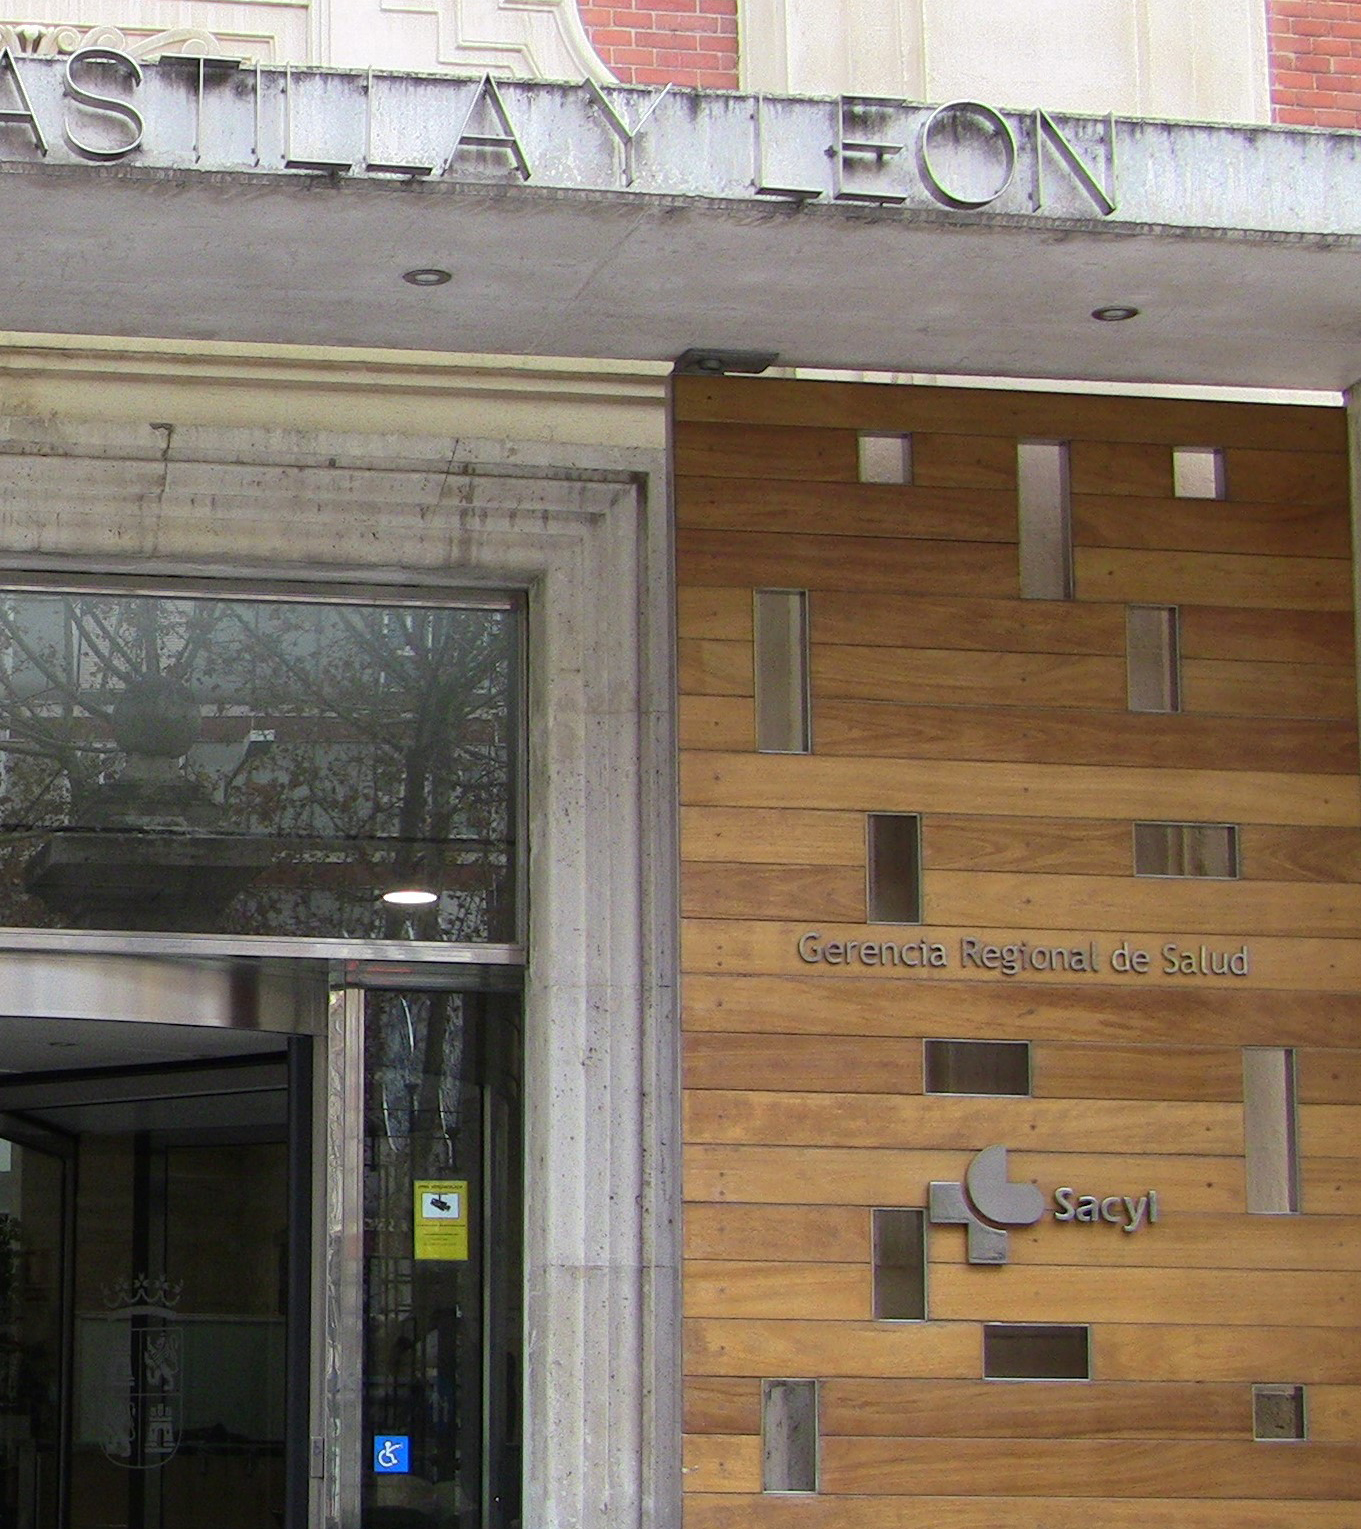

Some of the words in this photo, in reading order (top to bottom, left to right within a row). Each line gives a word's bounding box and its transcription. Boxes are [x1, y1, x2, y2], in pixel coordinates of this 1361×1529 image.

[581, 76, 674, 188] Y
[750, 95, 1117, 216] LEON
[798, 931, 948, 968] Gerencia
[961, 936, 1100, 976] Regional
[1110, 942, 1151, 974] de
[1161, 943, 1249, 977] Salud
[1054, 1186, 1159, 1232] Sacyl
